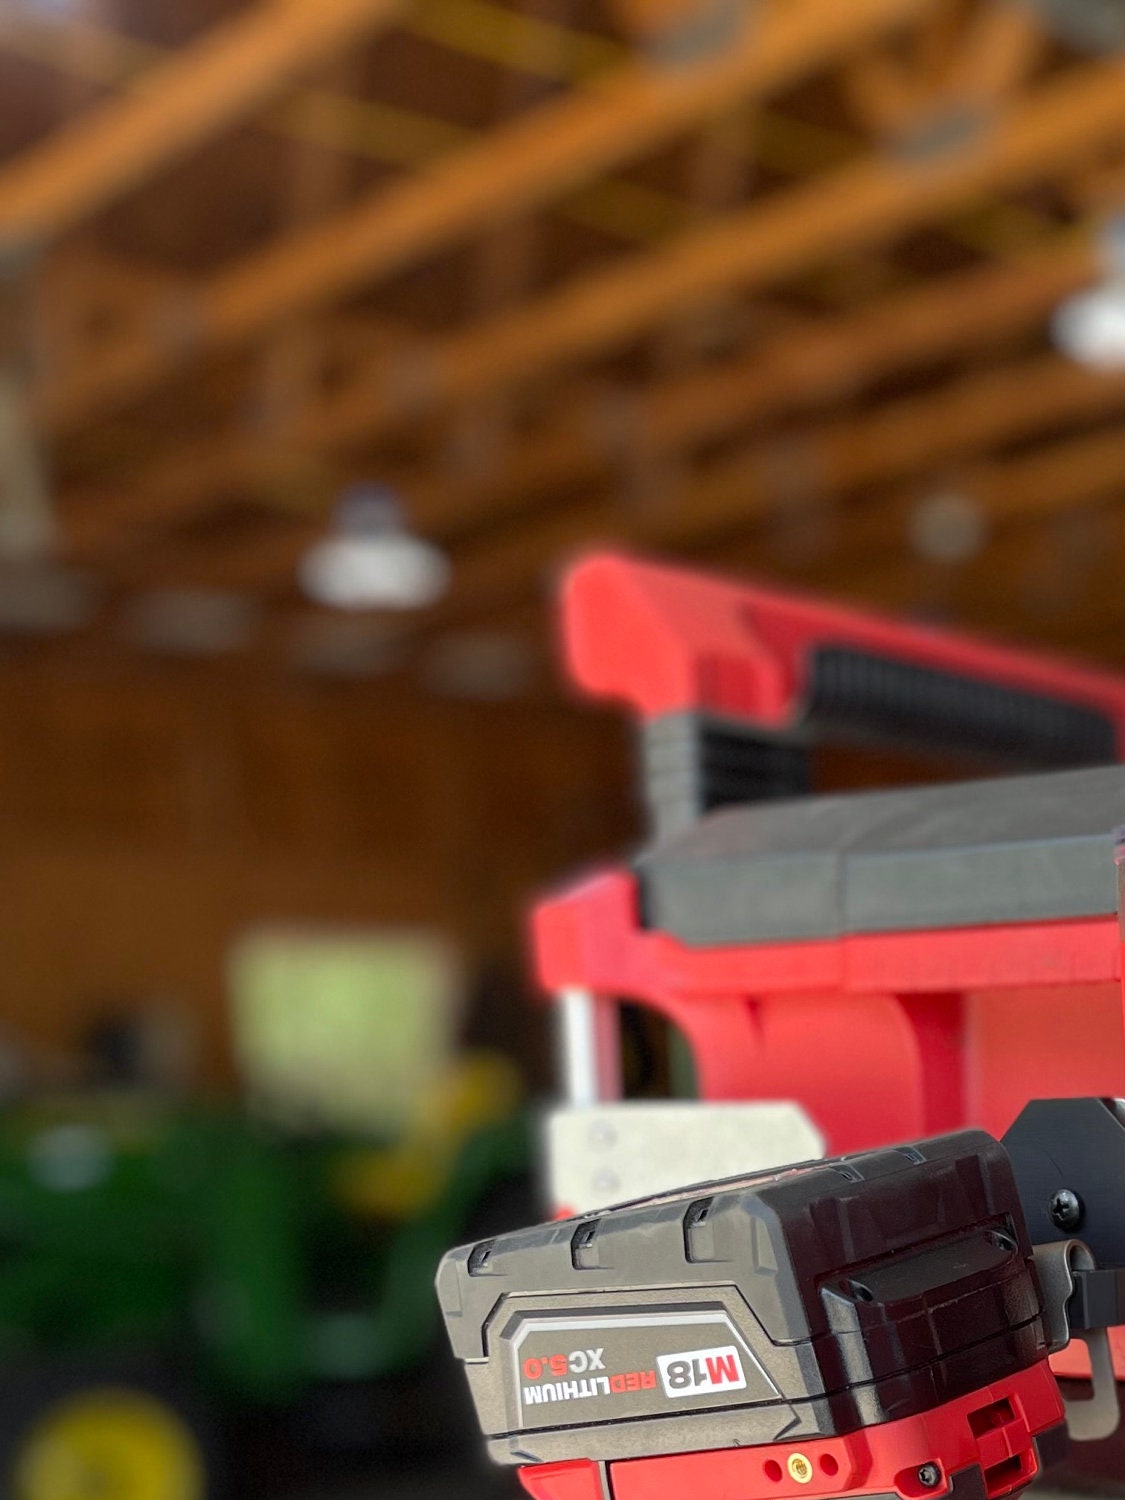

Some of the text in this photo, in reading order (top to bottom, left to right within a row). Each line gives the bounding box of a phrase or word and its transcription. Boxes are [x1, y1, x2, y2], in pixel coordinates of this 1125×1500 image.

[524, 1348, 606, 1380] XC5.0
[524, 1354, 739, 1405] M18 REDLITHIUM
